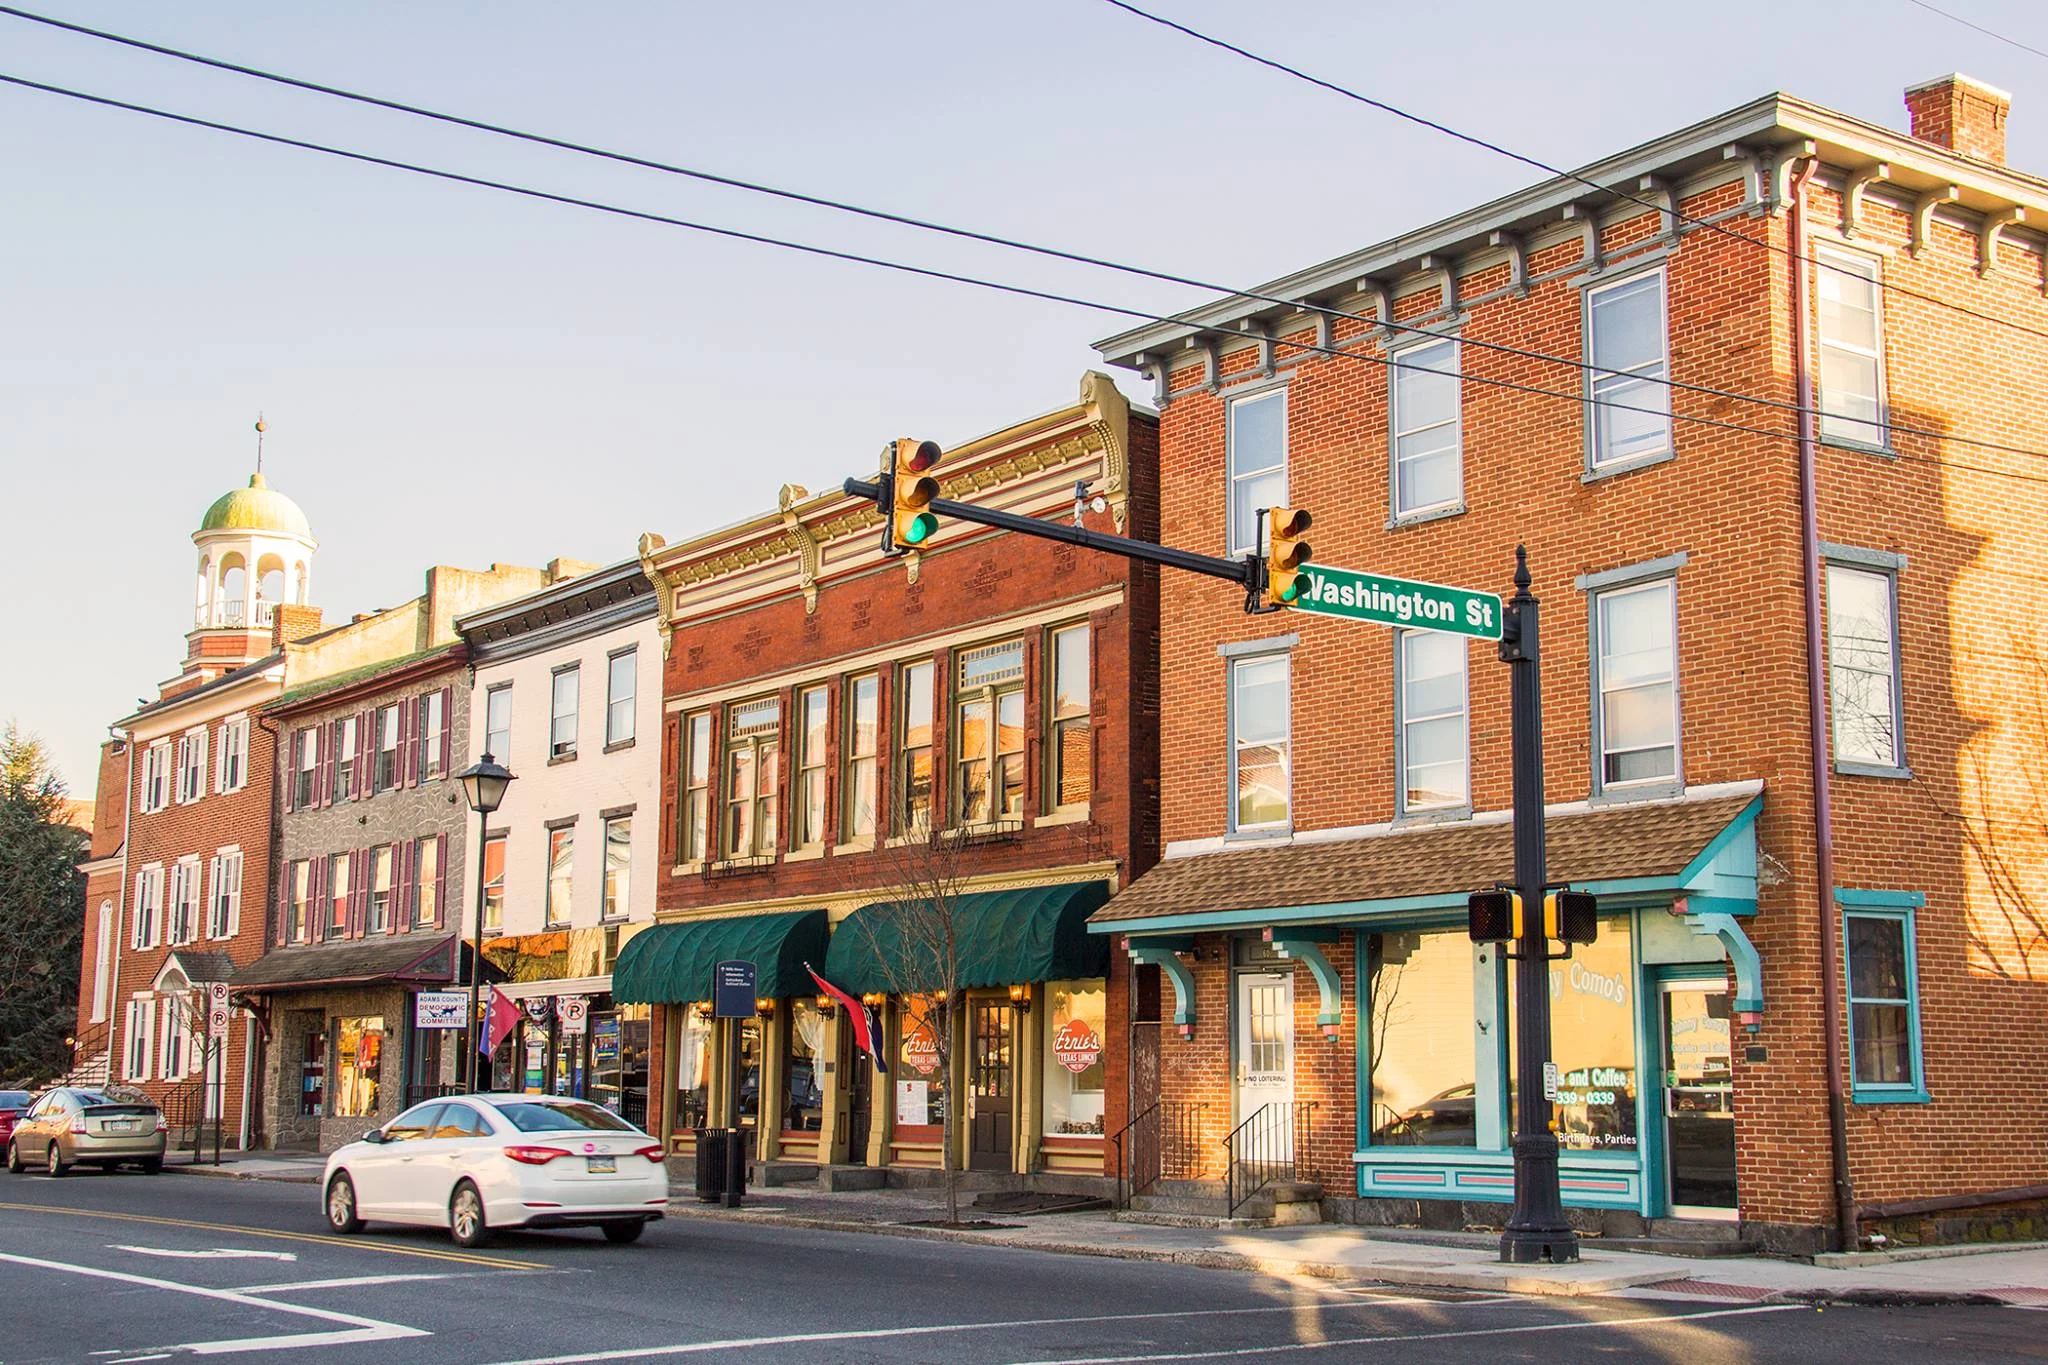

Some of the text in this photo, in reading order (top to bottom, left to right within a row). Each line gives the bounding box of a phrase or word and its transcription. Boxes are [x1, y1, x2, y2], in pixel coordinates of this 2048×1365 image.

[1298, 572, 1493, 628] Washington St
[1570, 961, 1626, 1004] Como's
[1055, 1028, 1100, 1051] Ernie's
[911, 1055, 926, 1064] TEXAS
[1060, 1053, 1095, 1062] TEXAS LUNCH
[1569, 1068, 1589, 1086] and
[1592, 1067, 1627, 1087] Coffee
[1558, 1132, 1637, 1146] Birthdays, Parties
